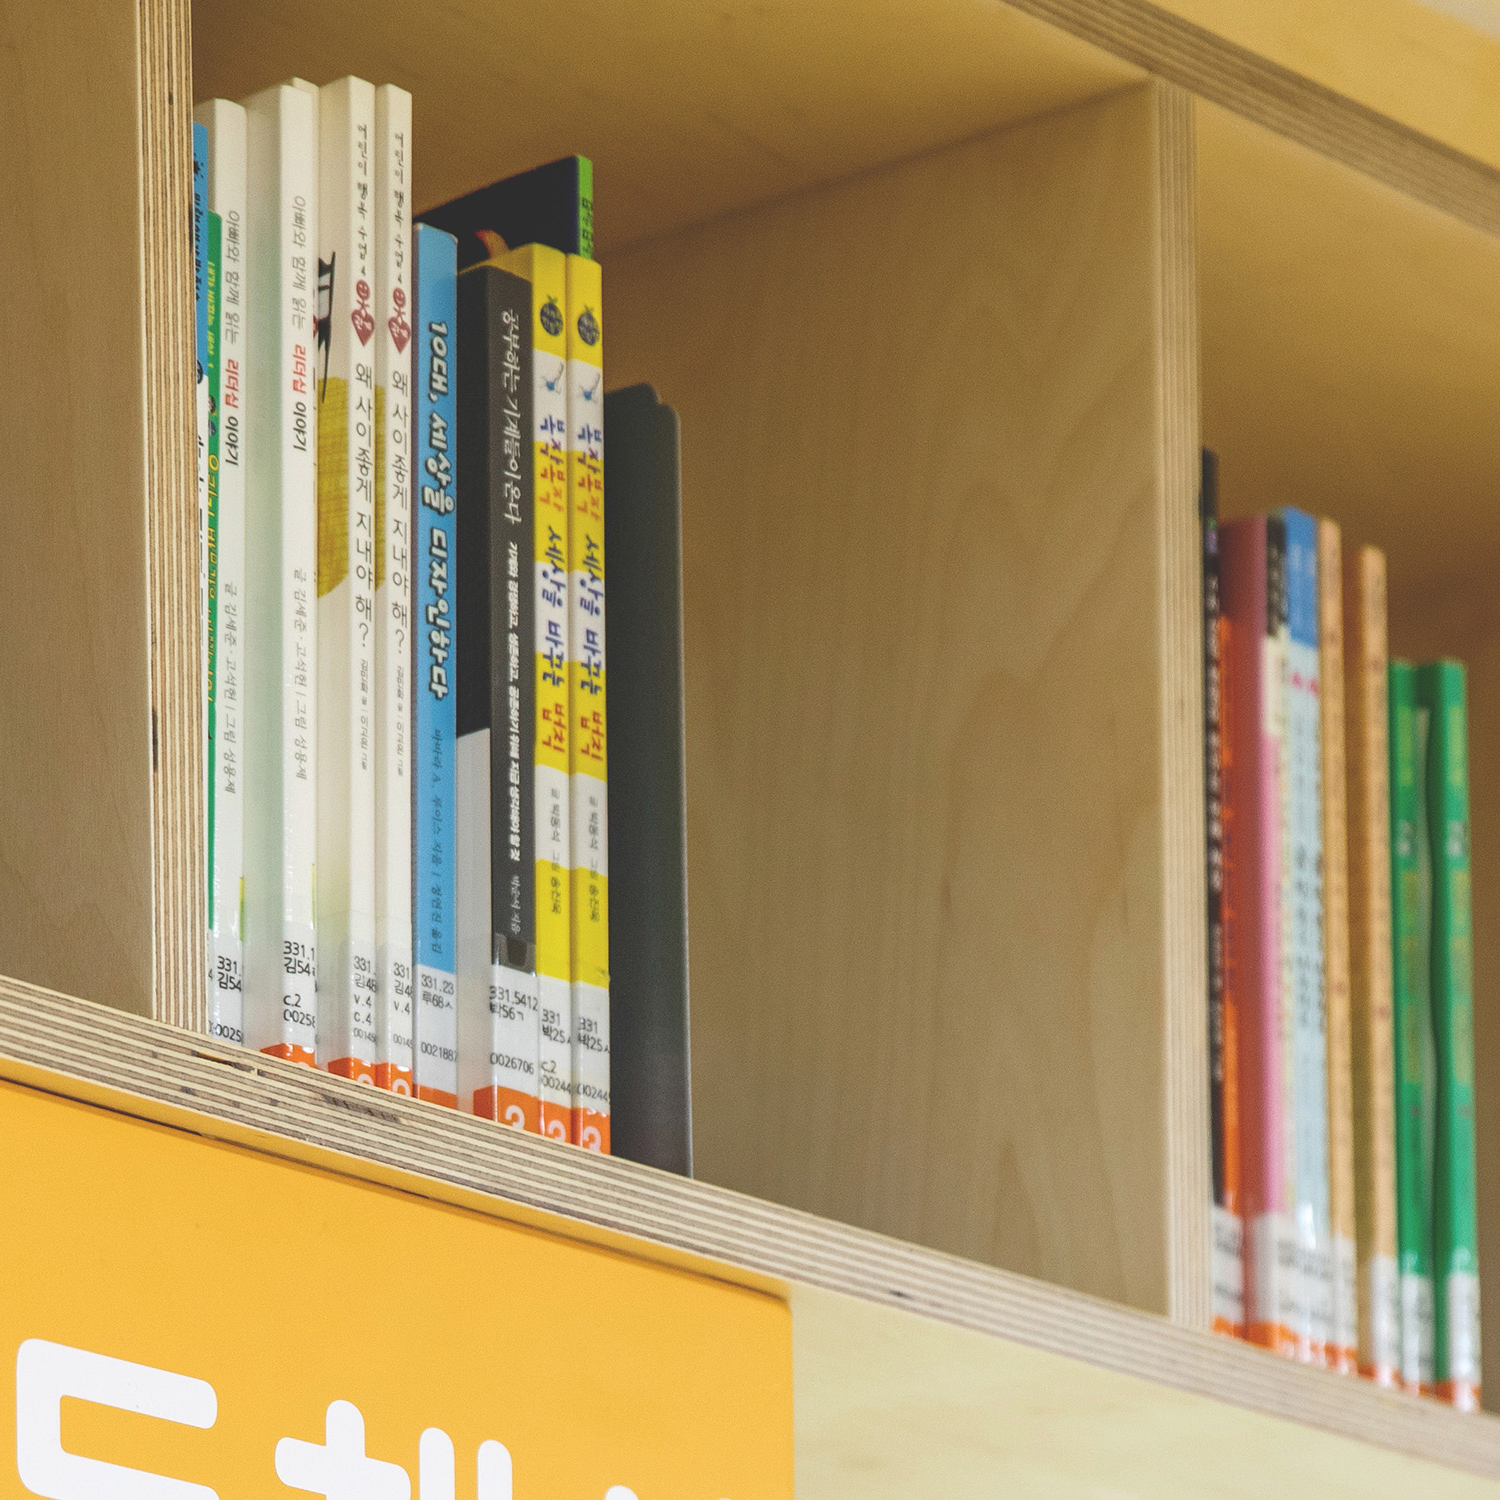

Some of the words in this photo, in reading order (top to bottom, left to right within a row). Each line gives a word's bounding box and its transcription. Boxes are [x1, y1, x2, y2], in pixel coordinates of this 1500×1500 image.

[226, 210, 242, 263] 아빠와
[292, 195, 307, 248] 아빠와
[226, 270, 241, 307] 함께
[292, 255, 307, 291] 함께
[225, 310, 241, 346] 읽는
[292, 294, 307, 331] 읽는
[293, 343, 307, 396] 리더십
[426, 320, 450, 404] 10대,
[502, 308, 521, 395] 공부하는
[225, 357, 240, 410] 리더십
[354, 362, 373, 396] 왜
[391, 369, 409, 398] 왜
[225, 415, 240, 467] 이야기
[293, 401, 308, 453] 이야기
[354, 396, 374, 503] 사이좋게
[503, 395, 522, 481] 기계들이
[391, 403, 410, 511] 사이좋게
[422, 410, 455, 517] 세상을
[540, 414, 565, 513] 복작복작
[578, 423, 603, 522] 복작복작
[504, 481, 523, 525] 온다
[293, 567, 308, 583] 글
[356, 512, 374, 591] 지내야
[391, 519, 410, 599] 지내야
[542, 525, 566, 608] 세상을
[580, 534, 604, 617] 세상을
[224, 581, 239, 598] 글
[425, 526, 452, 701] 디자인하다
[355, 595, 373, 648] 해?
[391, 601, 408, 655] 해?
[543, 620, 566, 690] 바꾸는
[580, 629, 602, 698] 바꾸는
[223, 712, 238, 744] 그림
[295, 698, 309, 731] 그림
[543, 702, 567, 756] 법칙
[580, 710, 604, 762] 법칙
[223, 747, 238, 795] 성용제
[295, 735, 309, 781] 성용제
[509, 759, 521, 785] 지금
[509, 784, 521, 834] 생각해야
[283, 940, 315, 961] 331.1
[283, 993, 302, 1009] c.2
[420, 973, 455, 996] 331.23
[489, 985, 539, 1012] 331.5412
[541, 1008, 561, 1022] 331
[578, 1016, 599, 1032] 331
[489, 1052, 535, 1075] 0026706
[583, 1126, 601, 1152] 3
